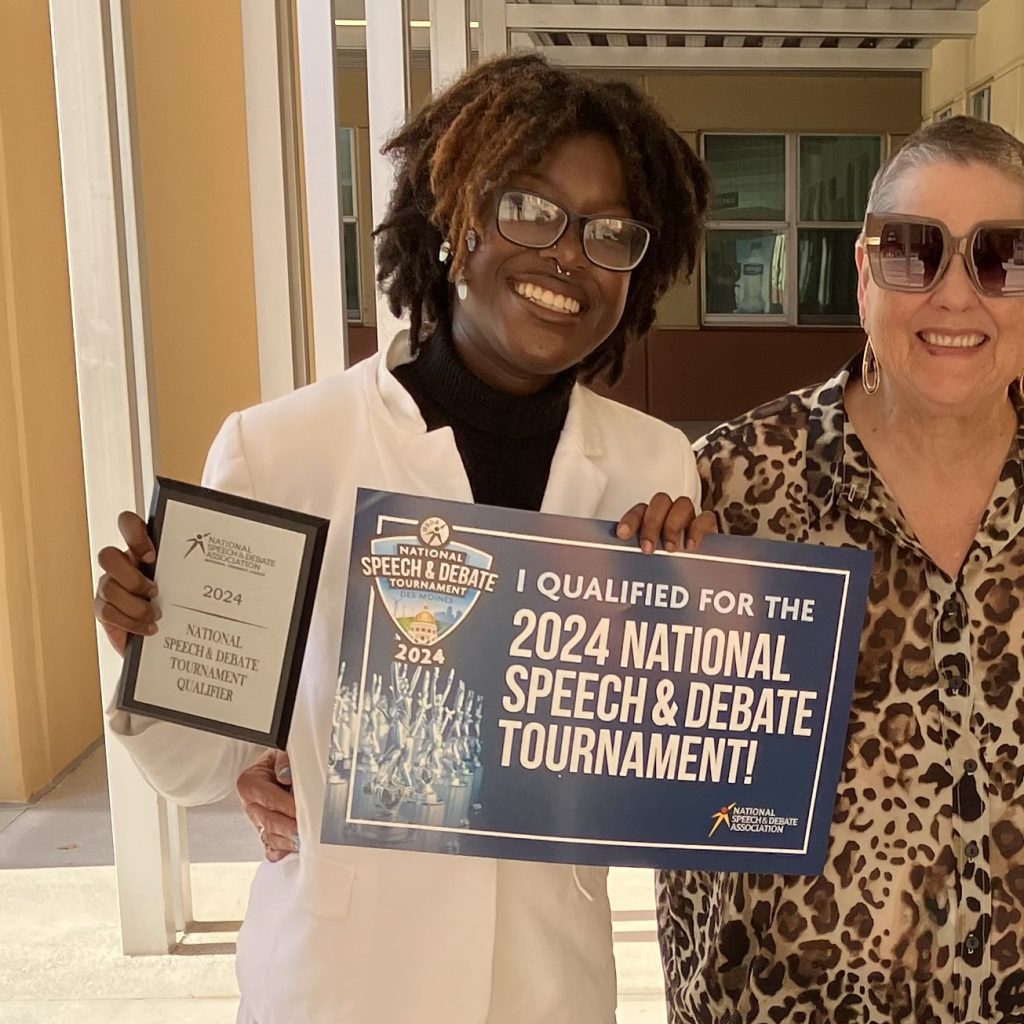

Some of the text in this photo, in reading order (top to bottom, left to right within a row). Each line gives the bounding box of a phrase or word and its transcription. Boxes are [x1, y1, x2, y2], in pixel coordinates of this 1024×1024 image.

[209, 536, 252, 553] NATIONAL
[400, 546, 464, 562] NATIONAL
[206, 552, 260, 570] ASSOCIATION
[246, 553, 276, 567] DEBATE
[361, 556, 498, 592] SPEECH & DEBATE
[203, 585, 242, 605] 2024
[390, 578, 468, 596] TOURNAMENT
[400, 590, 454, 604] DES MOINES
[516, 569, 815, 622] I QUALIFIED FOR THE
[186, 624, 243, 649] NATIONAL
[509, 608, 790, 682] 2024 NATIONAL
[163, 637, 260, 672] SPEECH & DEBATE
[394, 644, 445, 664] 2024
[170, 656, 247, 686] TOURNAMENT
[176, 678, 233, 702] QUALIFIER
[502, 665, 818, 737] SPEECH & DEBATE
[498, 719, 758, 786] TOURNAMENT!
[732, 816, 762, 824] SPEECH
[768, 817, 798, 826] DEBATE
[733, 807, 776, 816] NATIONAL
[730, 824, 784, 833] ASSOCIATION
